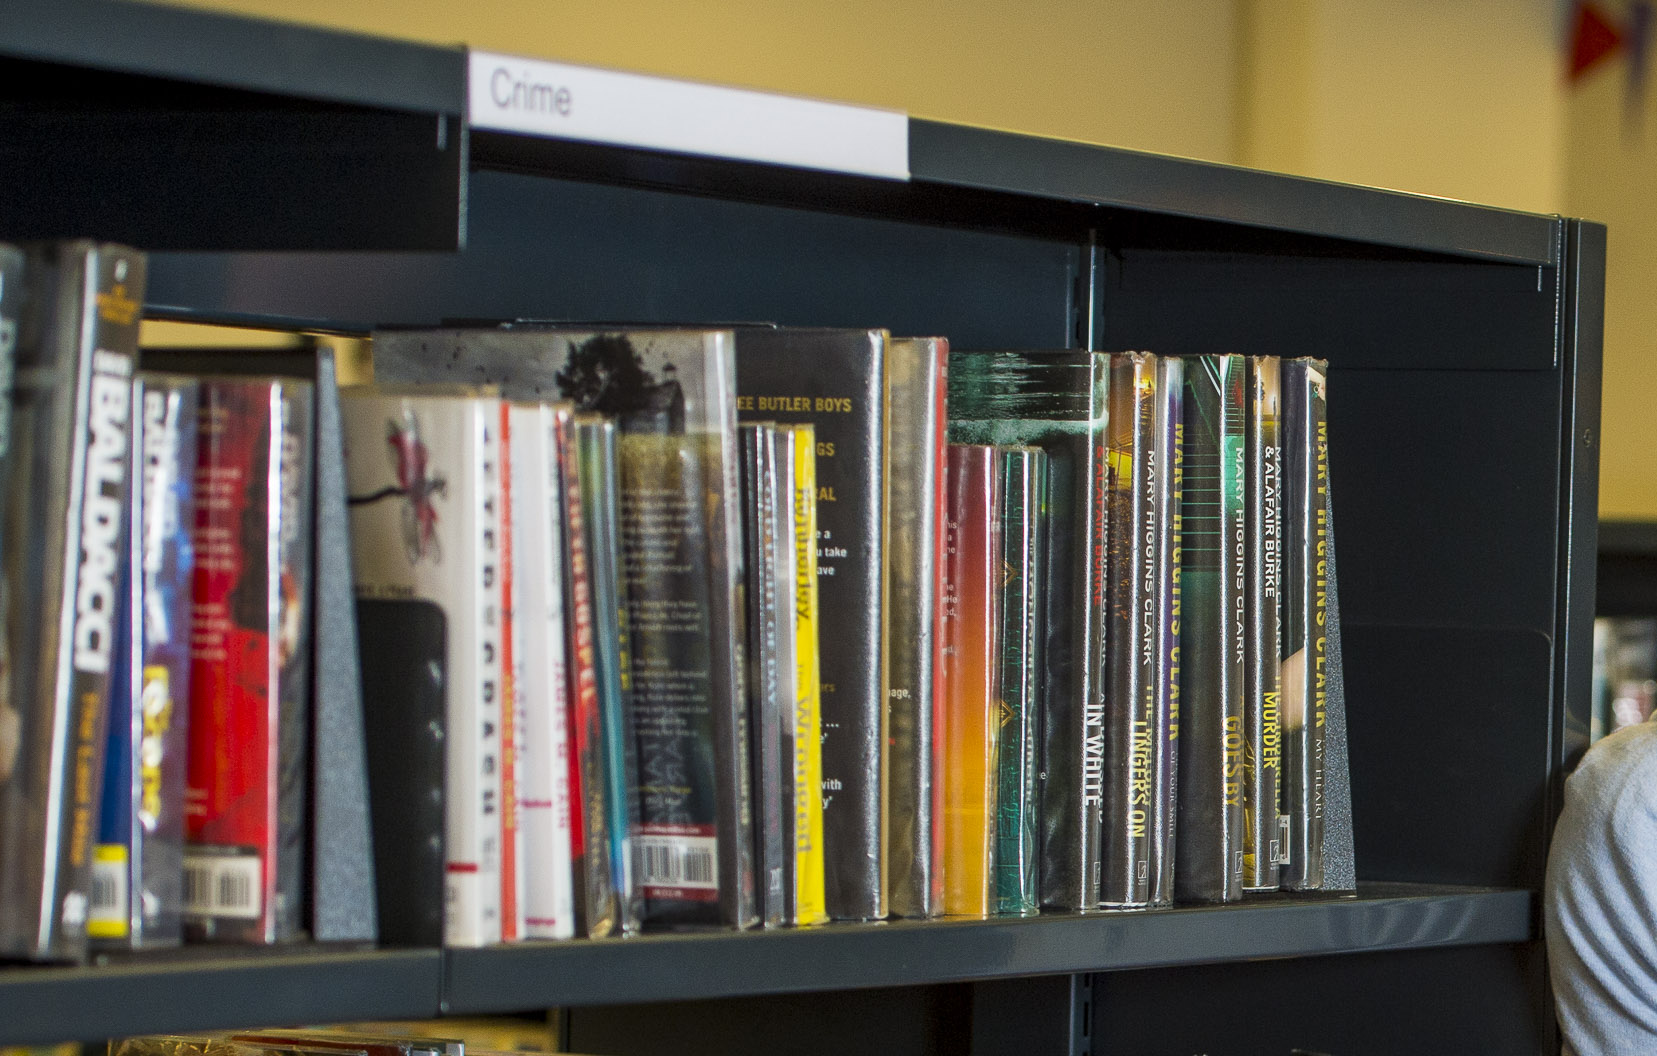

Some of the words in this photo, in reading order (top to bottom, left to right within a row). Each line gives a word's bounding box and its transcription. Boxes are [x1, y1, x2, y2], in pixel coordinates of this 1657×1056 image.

[489, 66, 573, 117] Crime
[758, 397, 811, 412] BUTLER
[815, 398, 852, 413] BOYS
[1146, 450, 1156, 504] MARY
[1235, 447, 1245, 504] MARY
[1264, 445, 1275, 459] &
[73, 374, 130, 675] BALDACCI
[1265, 461, 1275, 536] ALAFAIR
[824, 547, 847, 558] take
[1144, 511, 1155, 593] HIGGINS
[1235, 509, 1245, 590] HIGGINS
[1265, 539, 1275, 598] BURKE
[1316, 509, 1327, 627] HIGGINS
[1142, 599, 1154, 666] CLARK
[1235, 596, 1245, 664] CLARK
[1315, 636, 1327, 728] CLARK
[1086, 704, 1101, 726] IN
[1263, 691, 1278, 769] MURDER
[1085, 735, 1101, 807] WHITE
[1222, 716, 1242, 778] GOES
[1127, 810, 1146, 838] ON
[1224, 782, 1240, 807] BY
